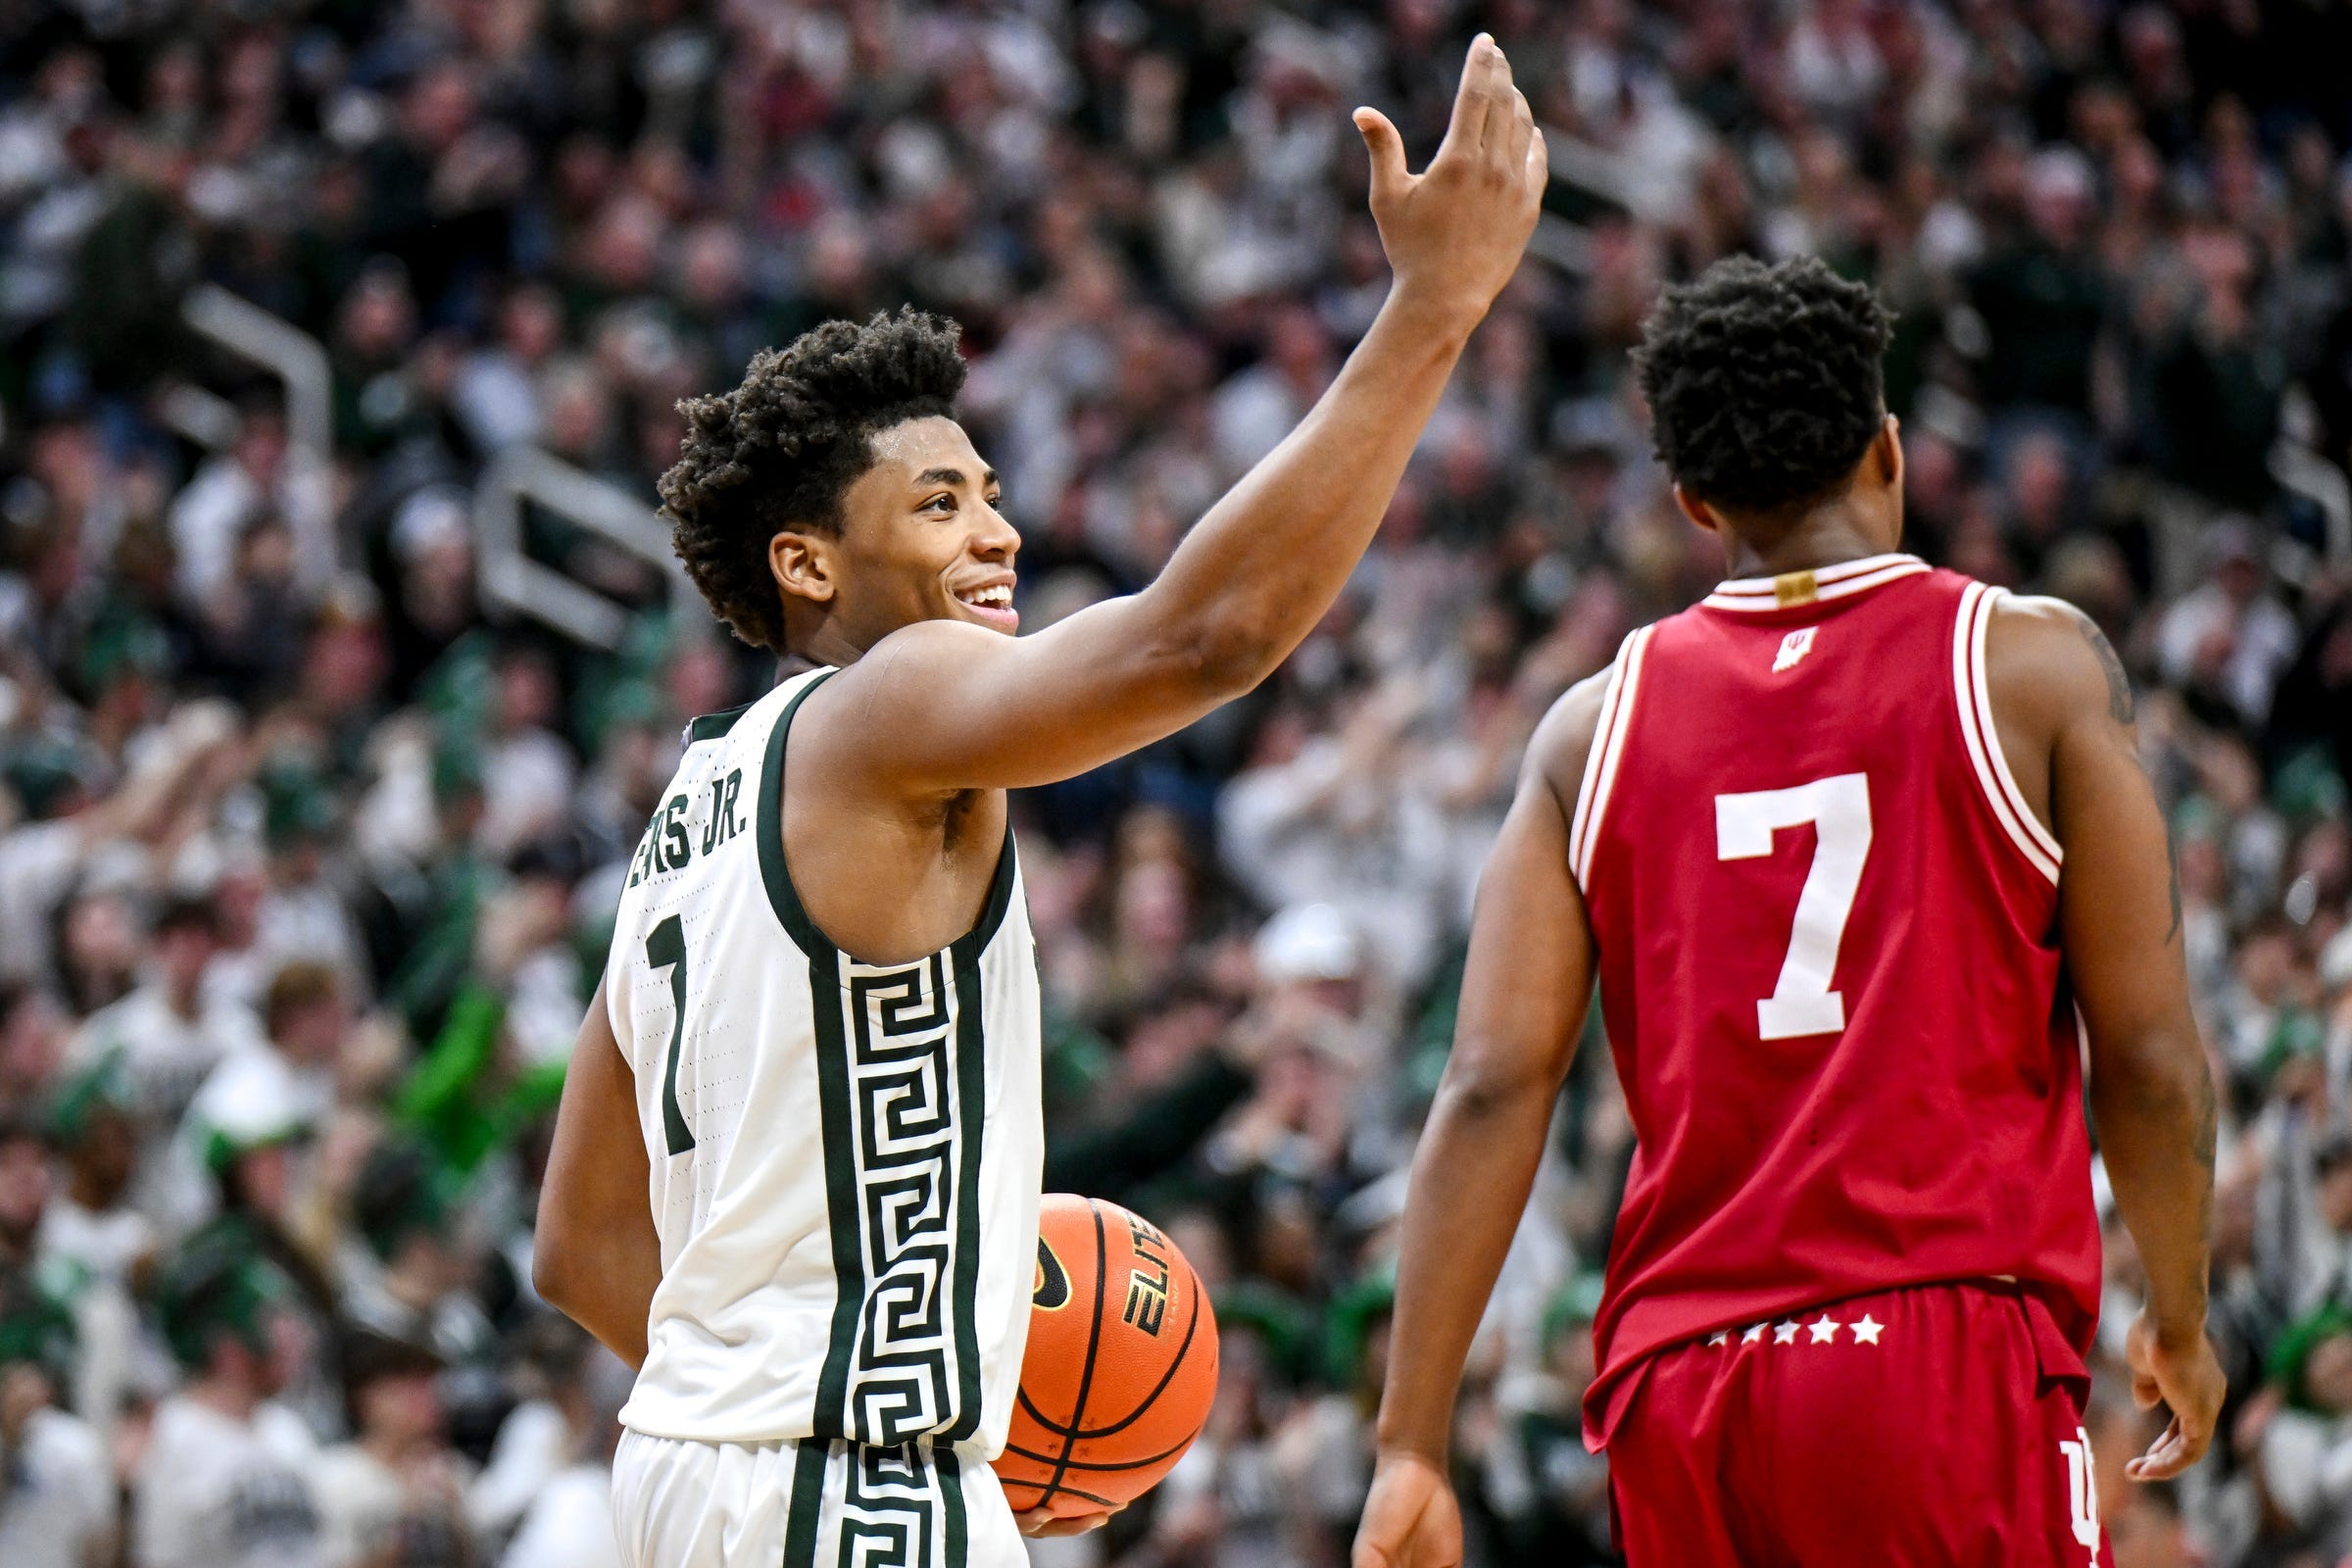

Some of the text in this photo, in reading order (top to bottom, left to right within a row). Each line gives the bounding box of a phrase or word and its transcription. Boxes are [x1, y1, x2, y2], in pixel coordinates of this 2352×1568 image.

[702, 767, 747, 857] JR.
[1714, 772, 1874, 1041] 7
[645, 913, 696, 1156] 1
